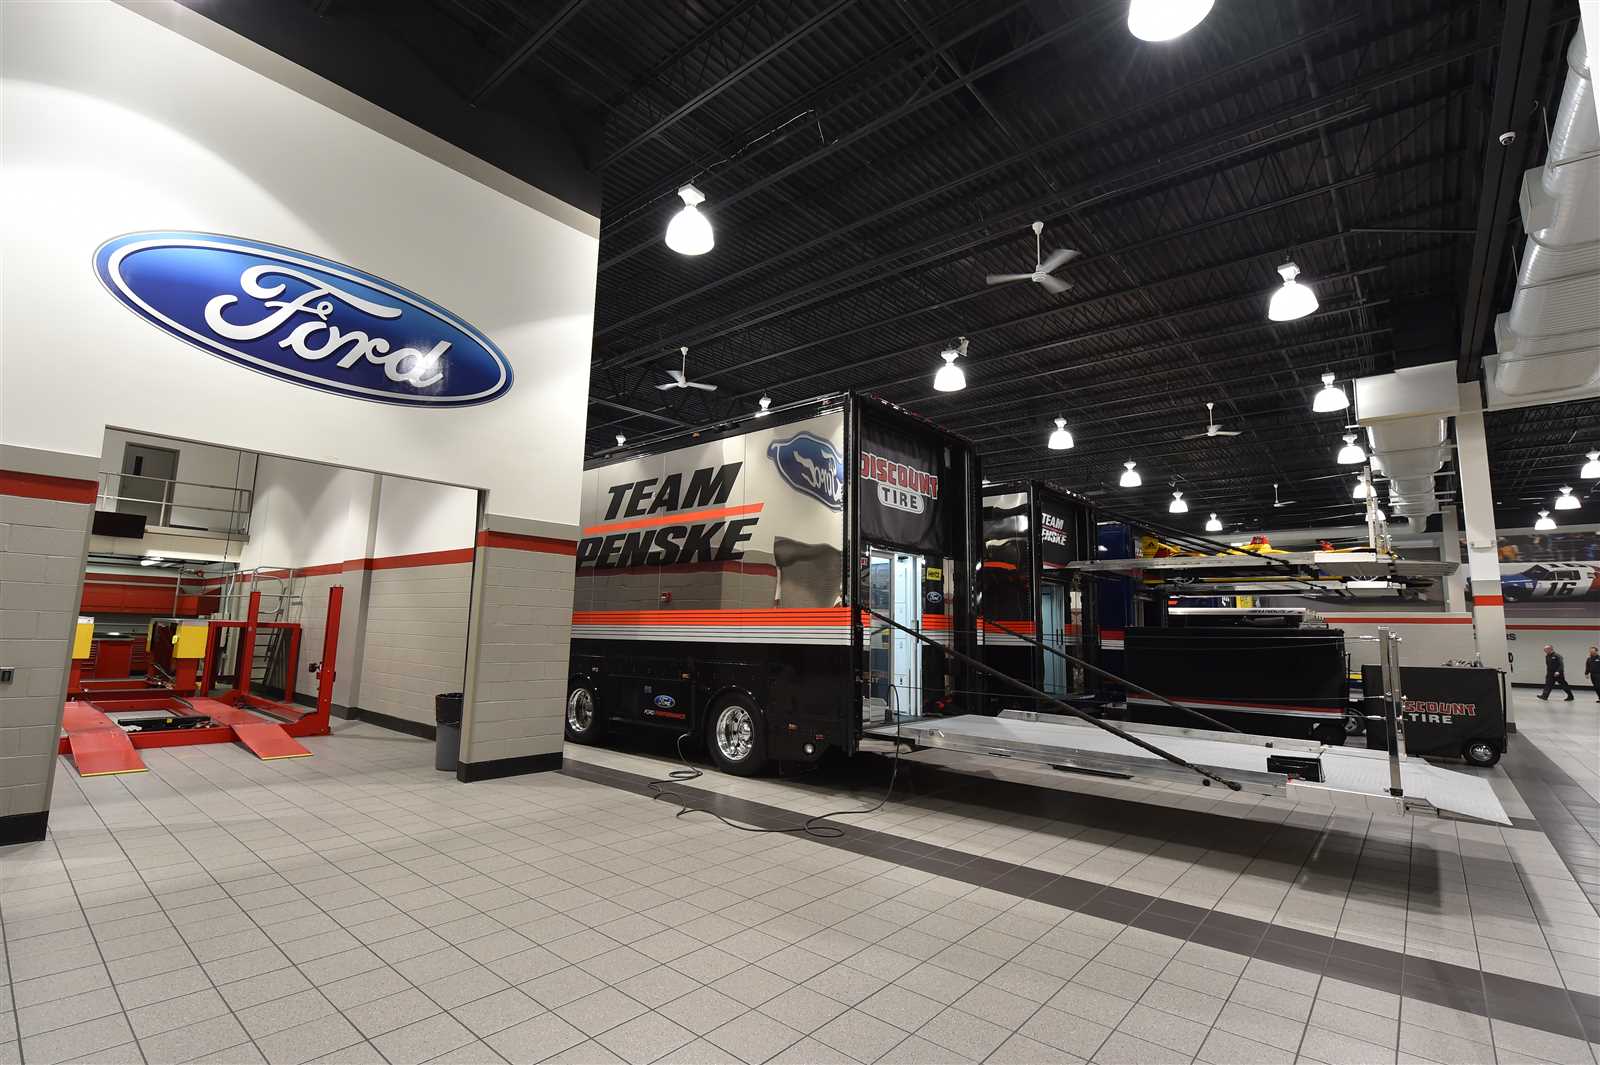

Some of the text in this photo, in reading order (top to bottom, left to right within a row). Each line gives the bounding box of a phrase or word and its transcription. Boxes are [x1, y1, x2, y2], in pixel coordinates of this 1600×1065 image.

[204, 264, 452, 387] Ford
[604, 461, 743, 520] TEAM
[879, 486, 919, 511] TIRE
[1041, 512, 1064, 530] TEAM
[576, 517, 760, 567] PENSKE
[1543, 582, 1577, 597] 16
[1402, 700, 1476, 716] SCOUNT
[1408, 713, 1453, 724] TIRE
